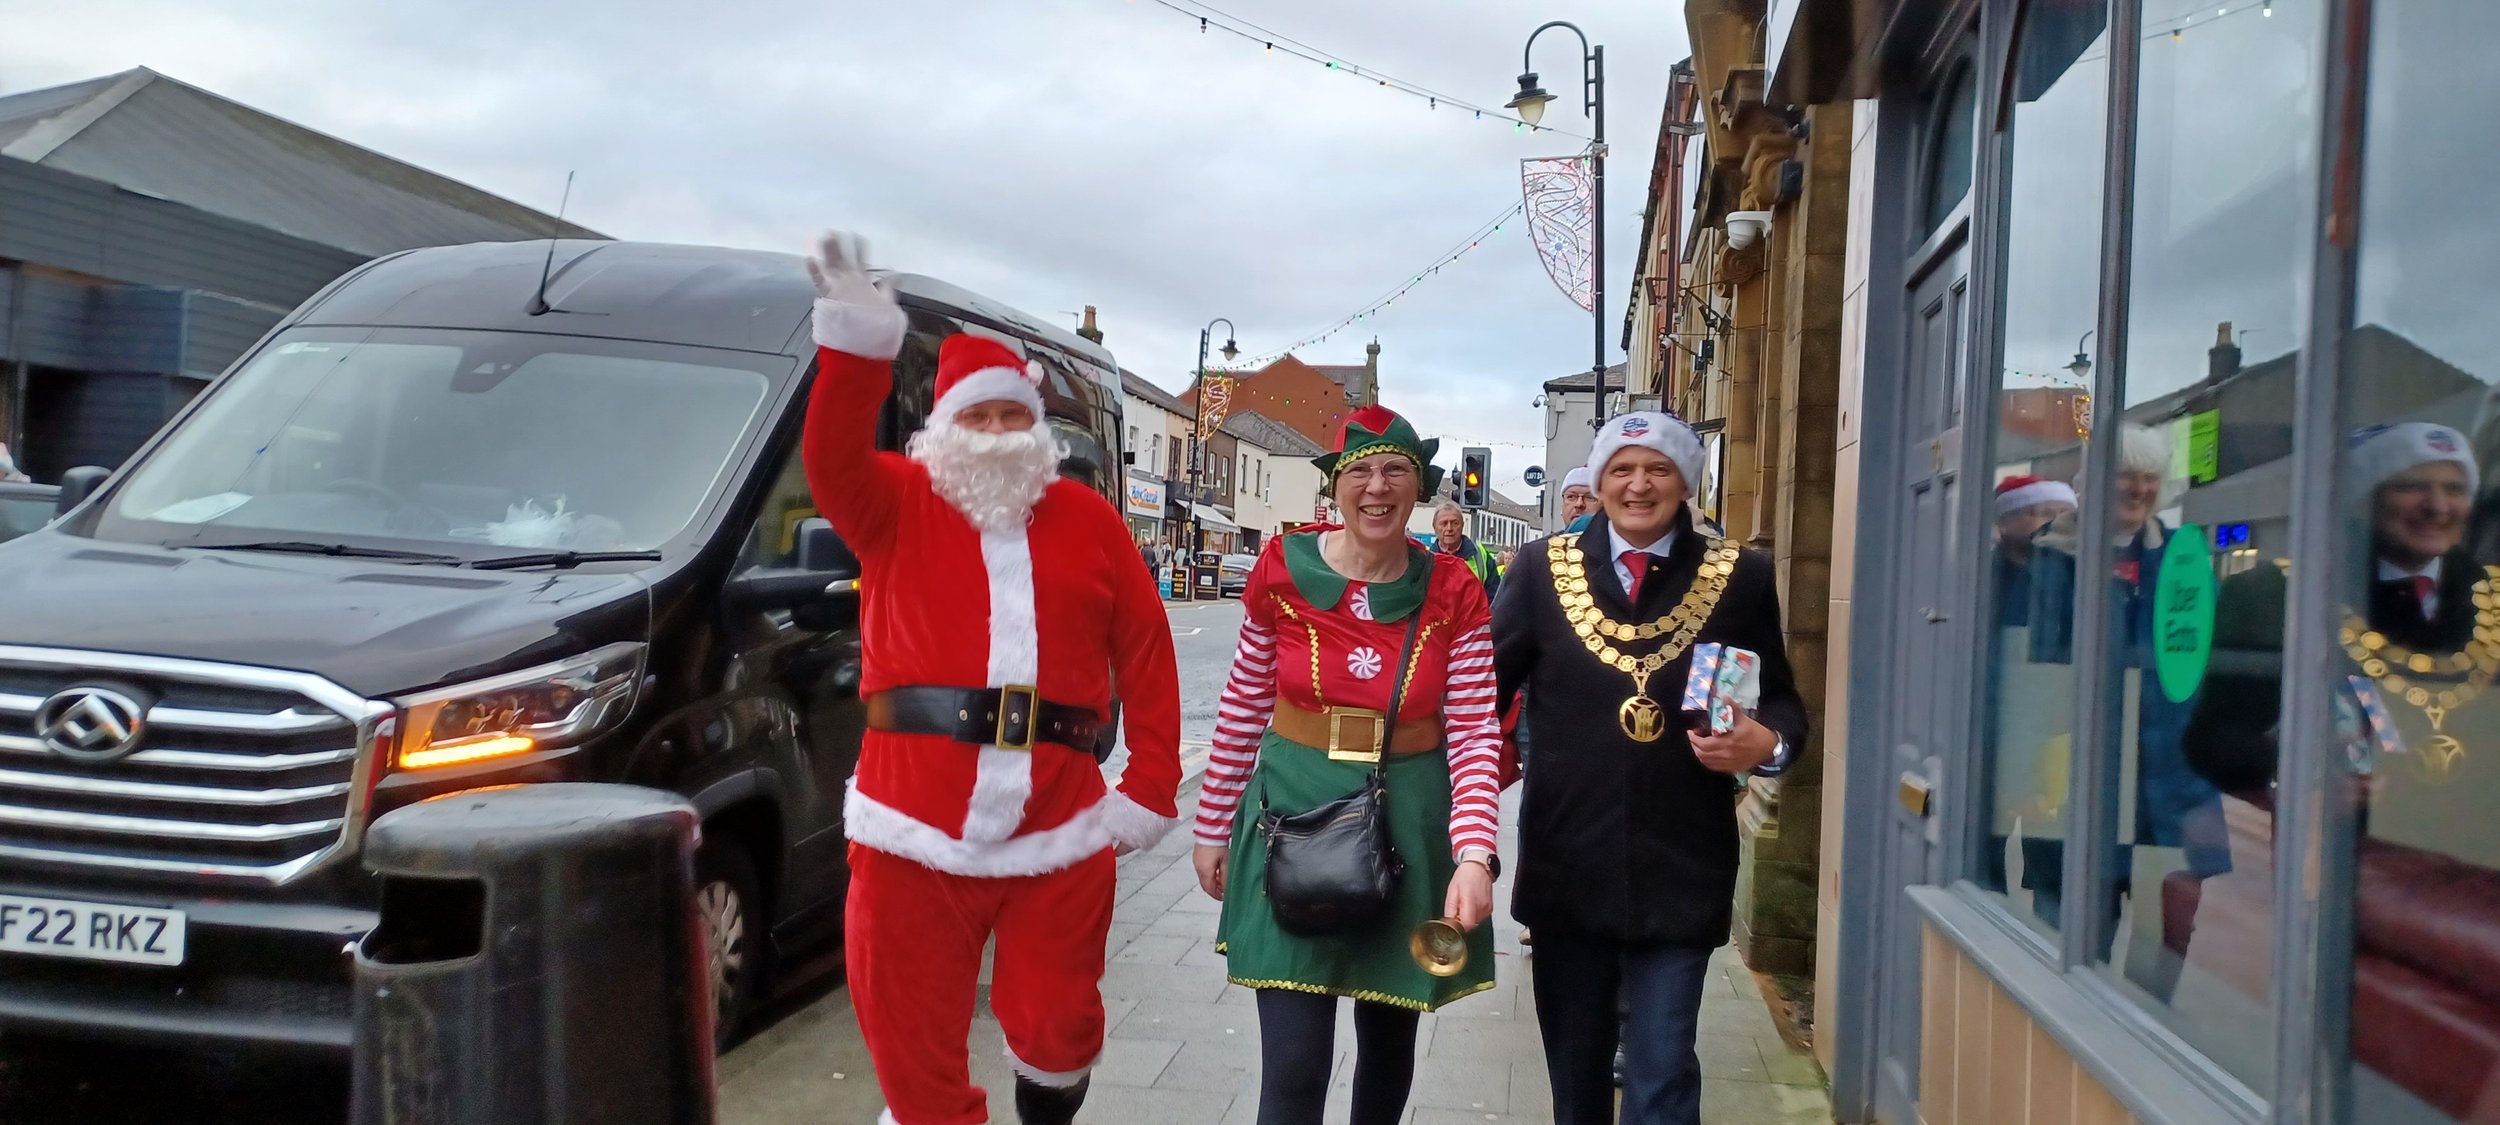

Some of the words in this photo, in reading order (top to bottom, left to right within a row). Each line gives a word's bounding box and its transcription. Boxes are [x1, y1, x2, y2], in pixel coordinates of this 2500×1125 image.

[2164, 619, 2198, 653] Eats
[0, 904, 76, 946] F22
[89, 911, 168, 954] RKZ
